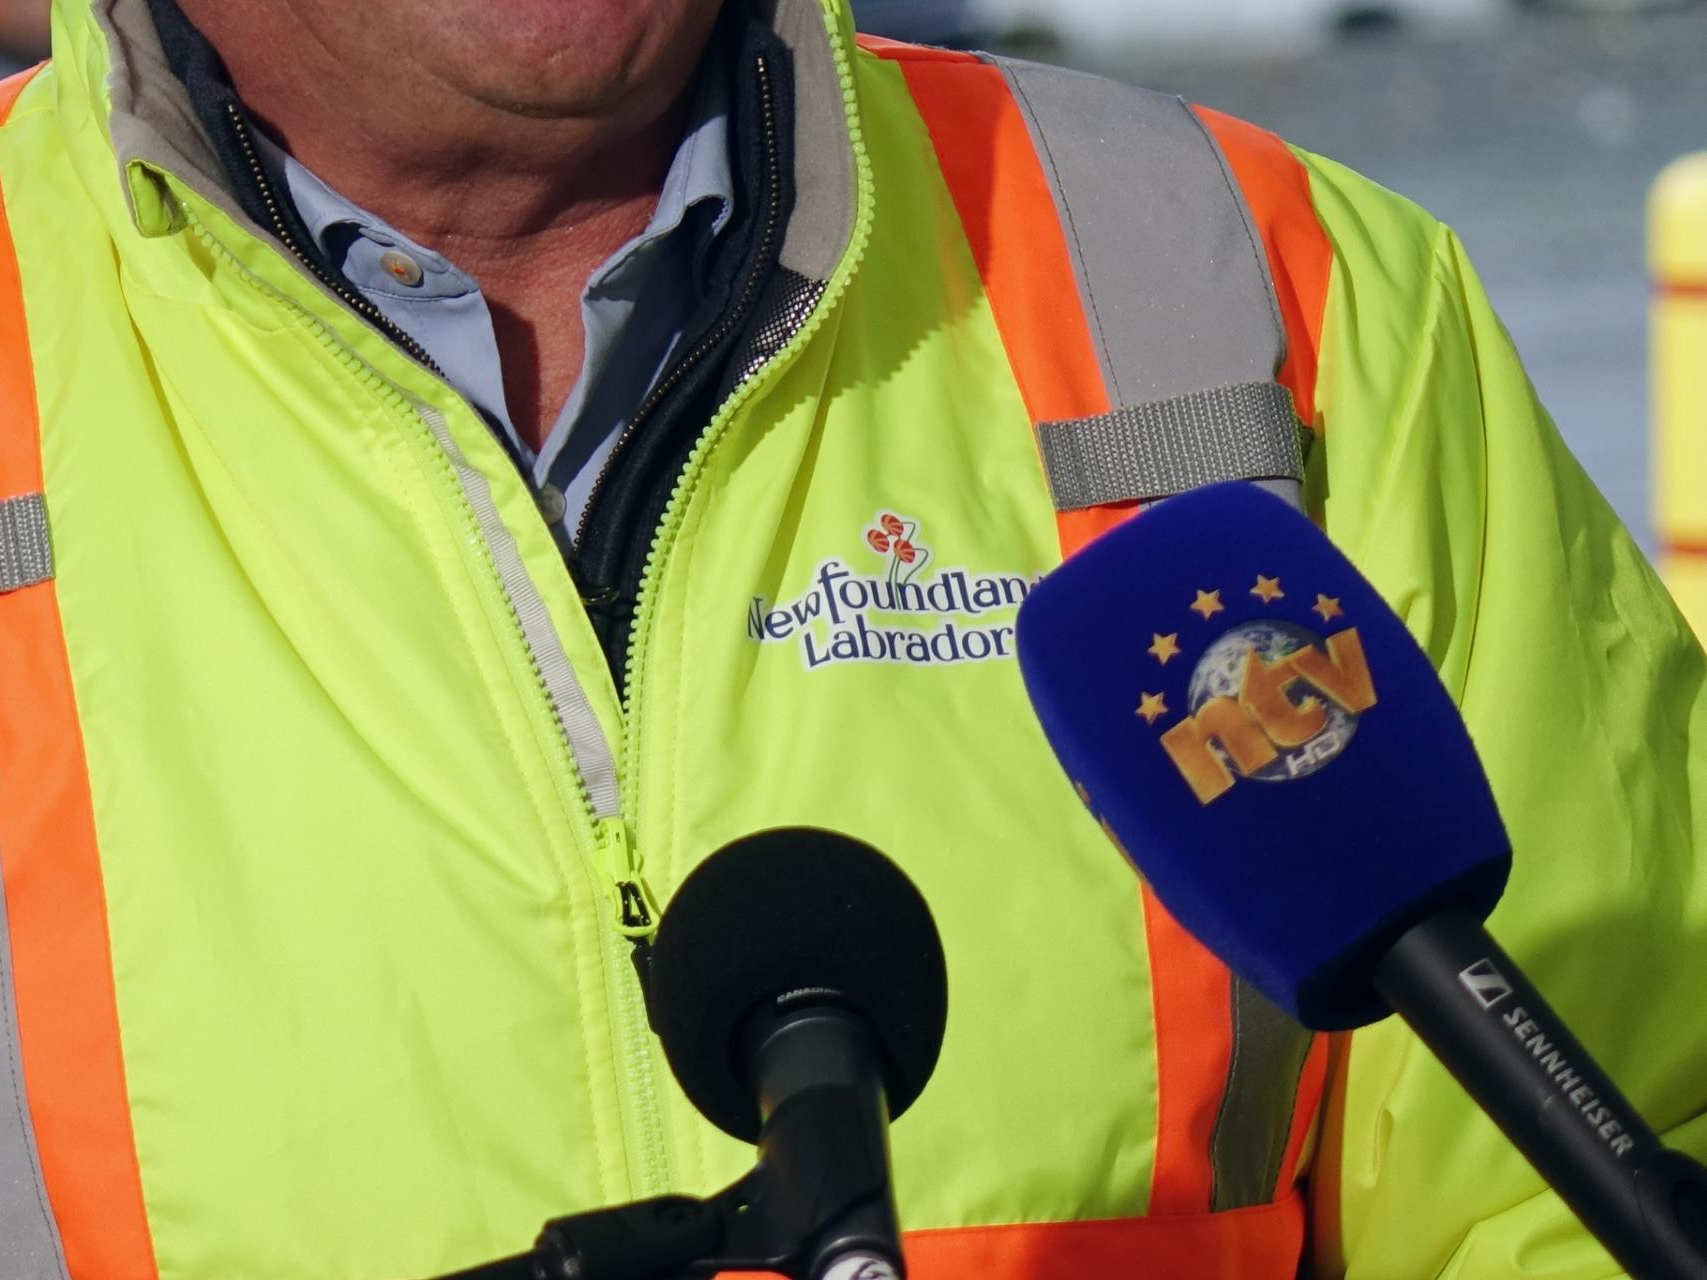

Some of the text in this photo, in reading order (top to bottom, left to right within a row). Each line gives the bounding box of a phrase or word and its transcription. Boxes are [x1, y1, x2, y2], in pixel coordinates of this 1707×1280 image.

[748, 562, 1044, 640] Newfoundlan
[805, 614, 1013, 667] Labrador
[1286, 731, 1341, 776] HD
[1502, 1006, 1634, 1158] SENNHEISER
